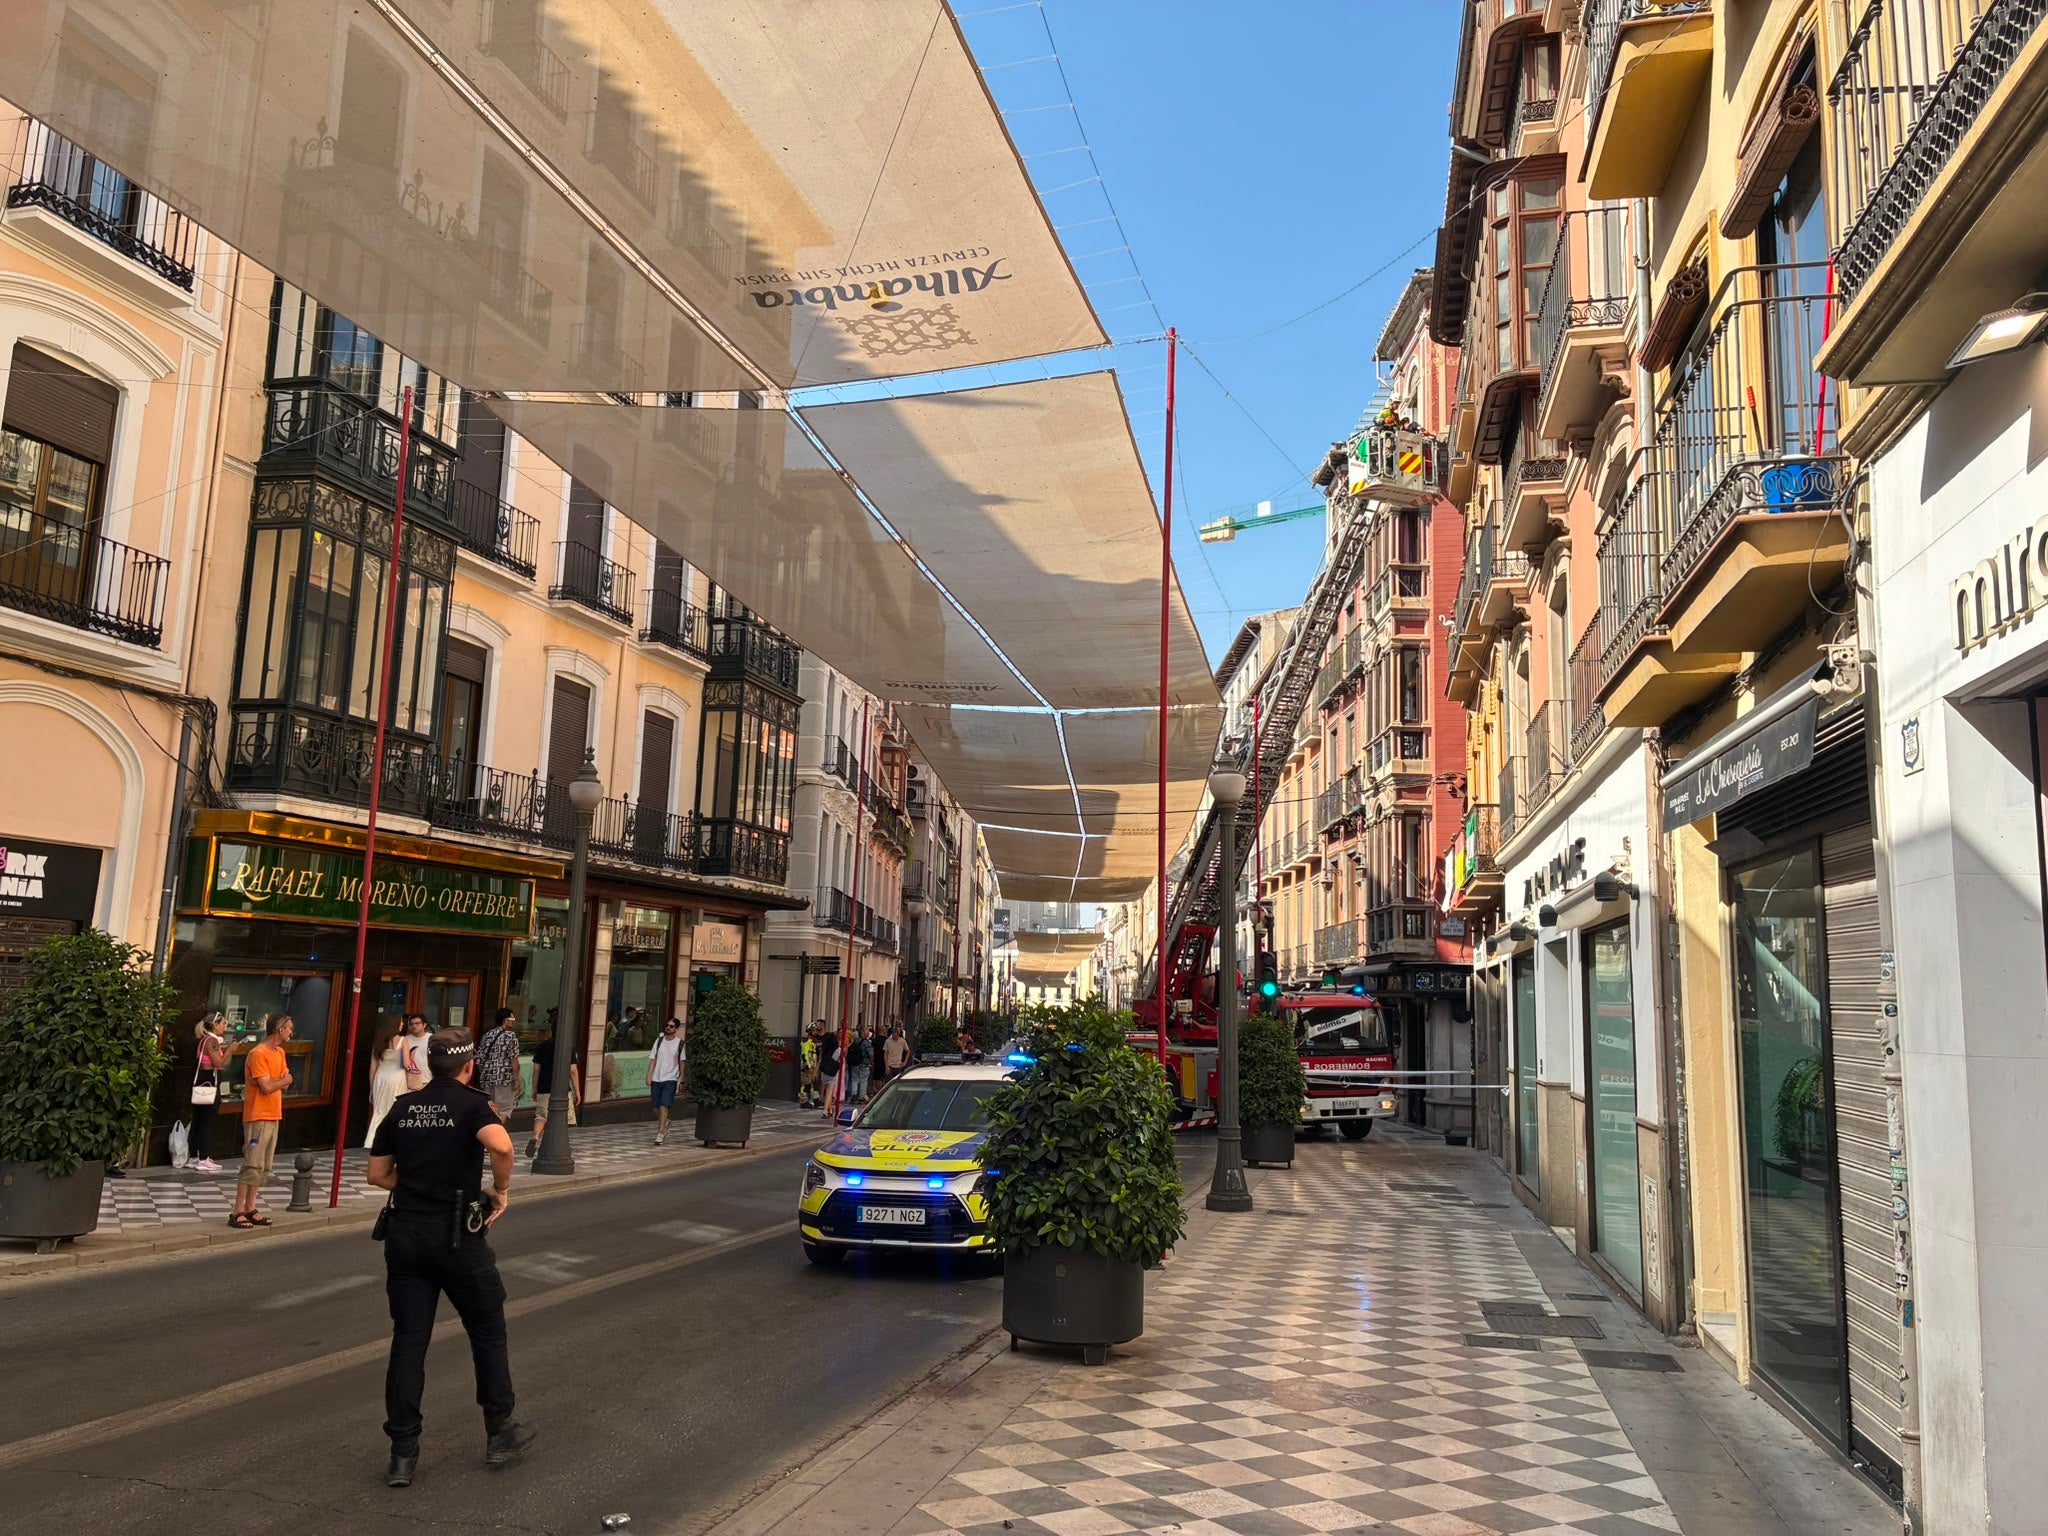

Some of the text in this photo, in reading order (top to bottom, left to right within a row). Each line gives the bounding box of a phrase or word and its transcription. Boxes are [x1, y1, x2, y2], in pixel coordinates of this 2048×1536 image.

[734, 246, 990, 286] CERVEZA HECHA SIN PRISA
[750, 257, 1012, 310] Alhambra
[1695, 767, 1711, 804] La
[230, 862, 518, 918] RAFAEL MORENO ORFEBRE
[398, 1118, 455, 1128] GRANADA
[408, 1104, 447, 1114] POLICIA
[865, 1208, 923, 1223] 9271 NGZ
